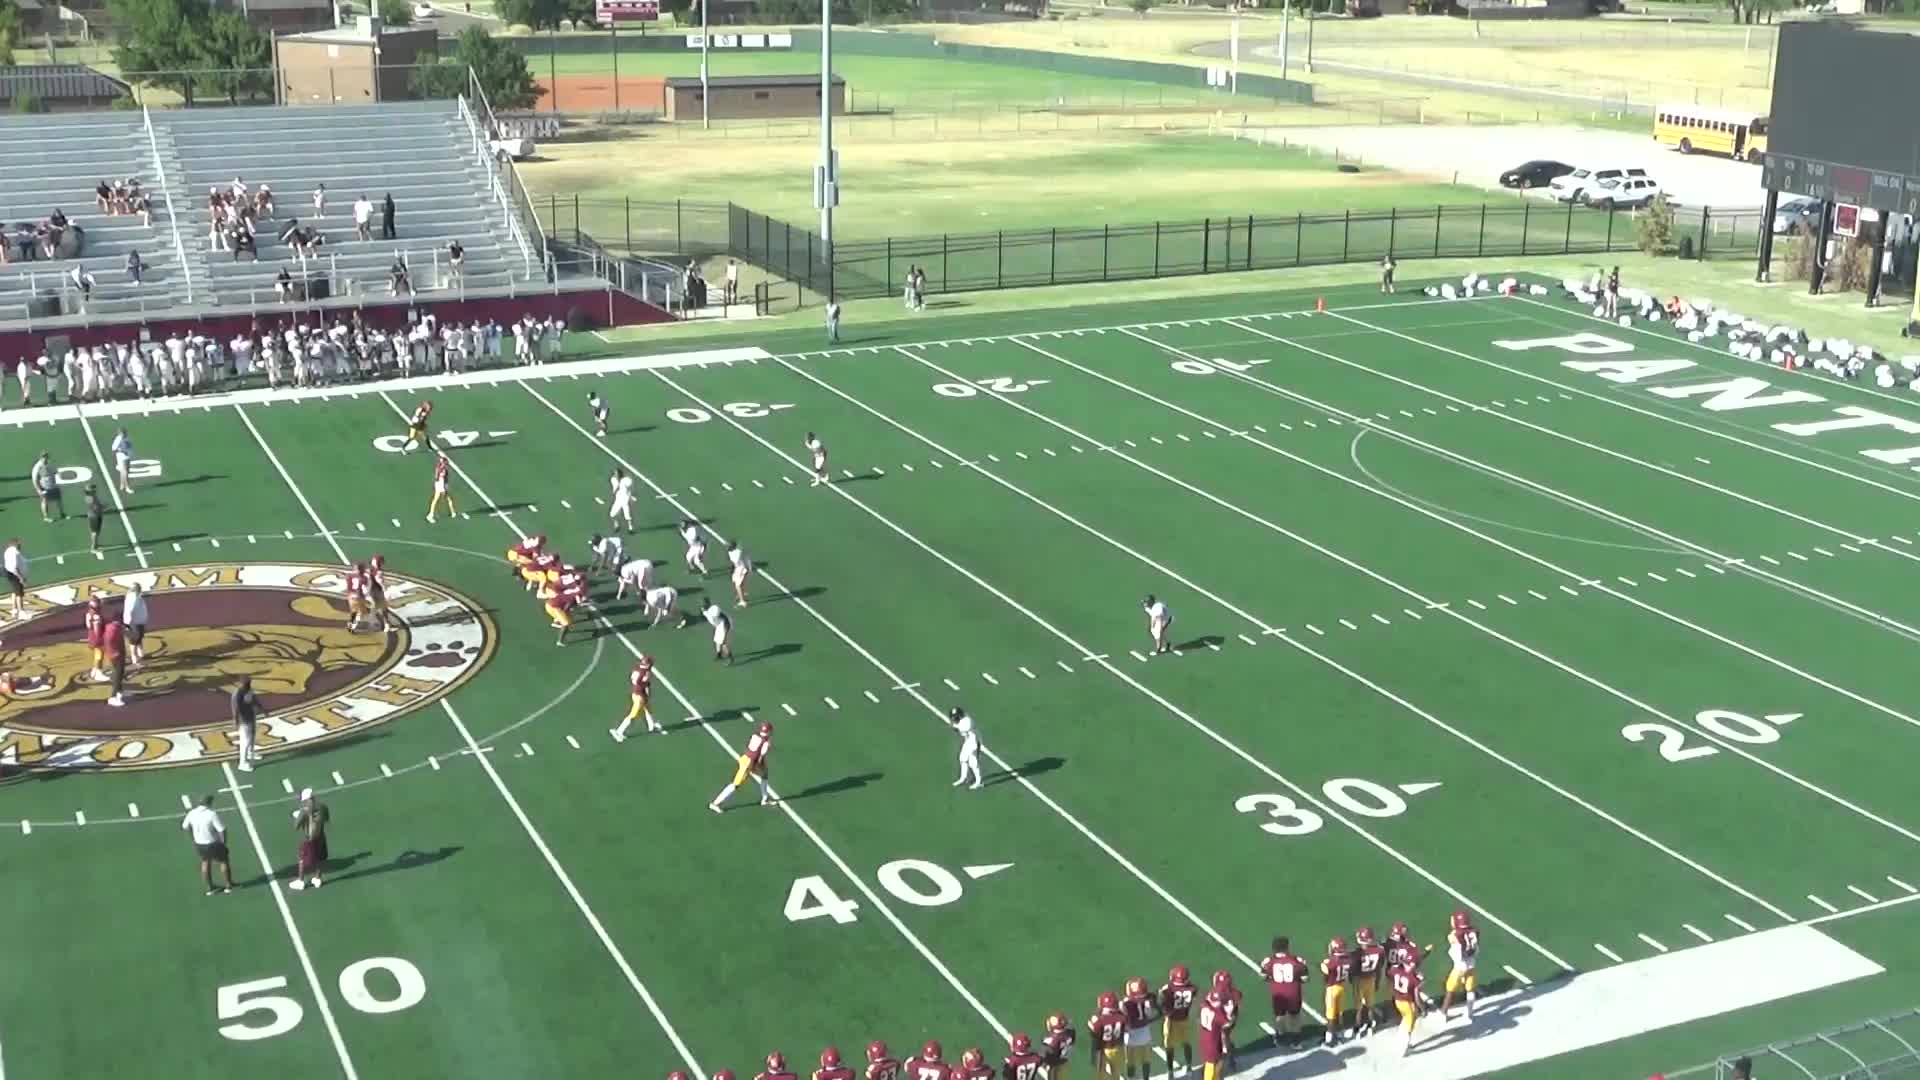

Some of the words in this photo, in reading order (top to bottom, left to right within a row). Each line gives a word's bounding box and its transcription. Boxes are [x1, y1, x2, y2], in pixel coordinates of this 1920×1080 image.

[1171, 357, 1256, 376] 10
[932, 377, 1028, 398] 20
[666, 402, 769, 424] 30
[373, 429, 480, 453] 40
[1622, 709, 1780, 762] 20
[1235, 778, 1407, 836] 30
[784, 859, 964, 925] 40
[1361, 953, 1380, 972] 27
[216, 956, 427, 1040] 50
[1102, 1021, 1122, 1041] 24
